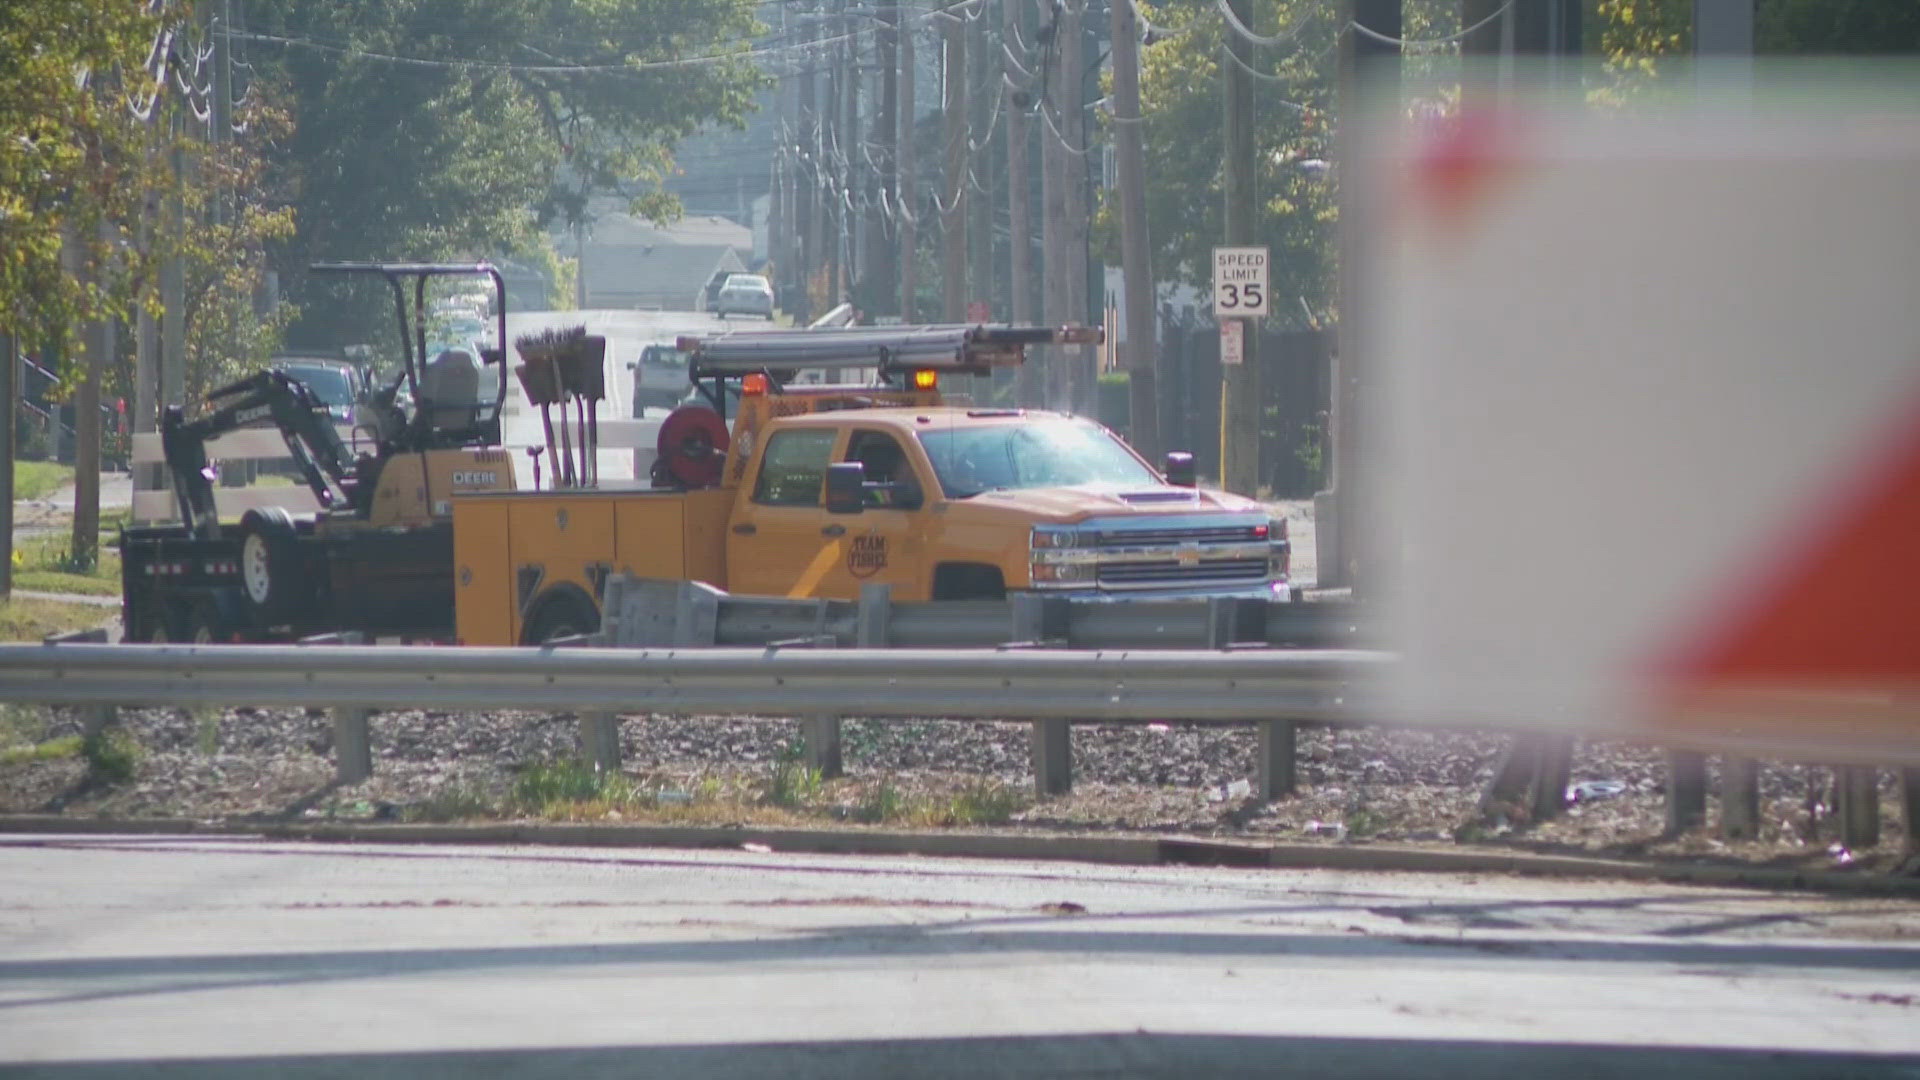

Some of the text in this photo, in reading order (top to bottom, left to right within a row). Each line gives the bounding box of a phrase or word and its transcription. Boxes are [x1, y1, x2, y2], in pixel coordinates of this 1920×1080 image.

[1219, 254, 1264, 266] SPEED
[1223, 269, 1258, 280] LIMIT
[1220, 283, 1262, 308] 35
[235, 404, 271, 424] DEERE
[453, 471, 497, 484] DEERE
[854, 535, 887, 551] TEAM
